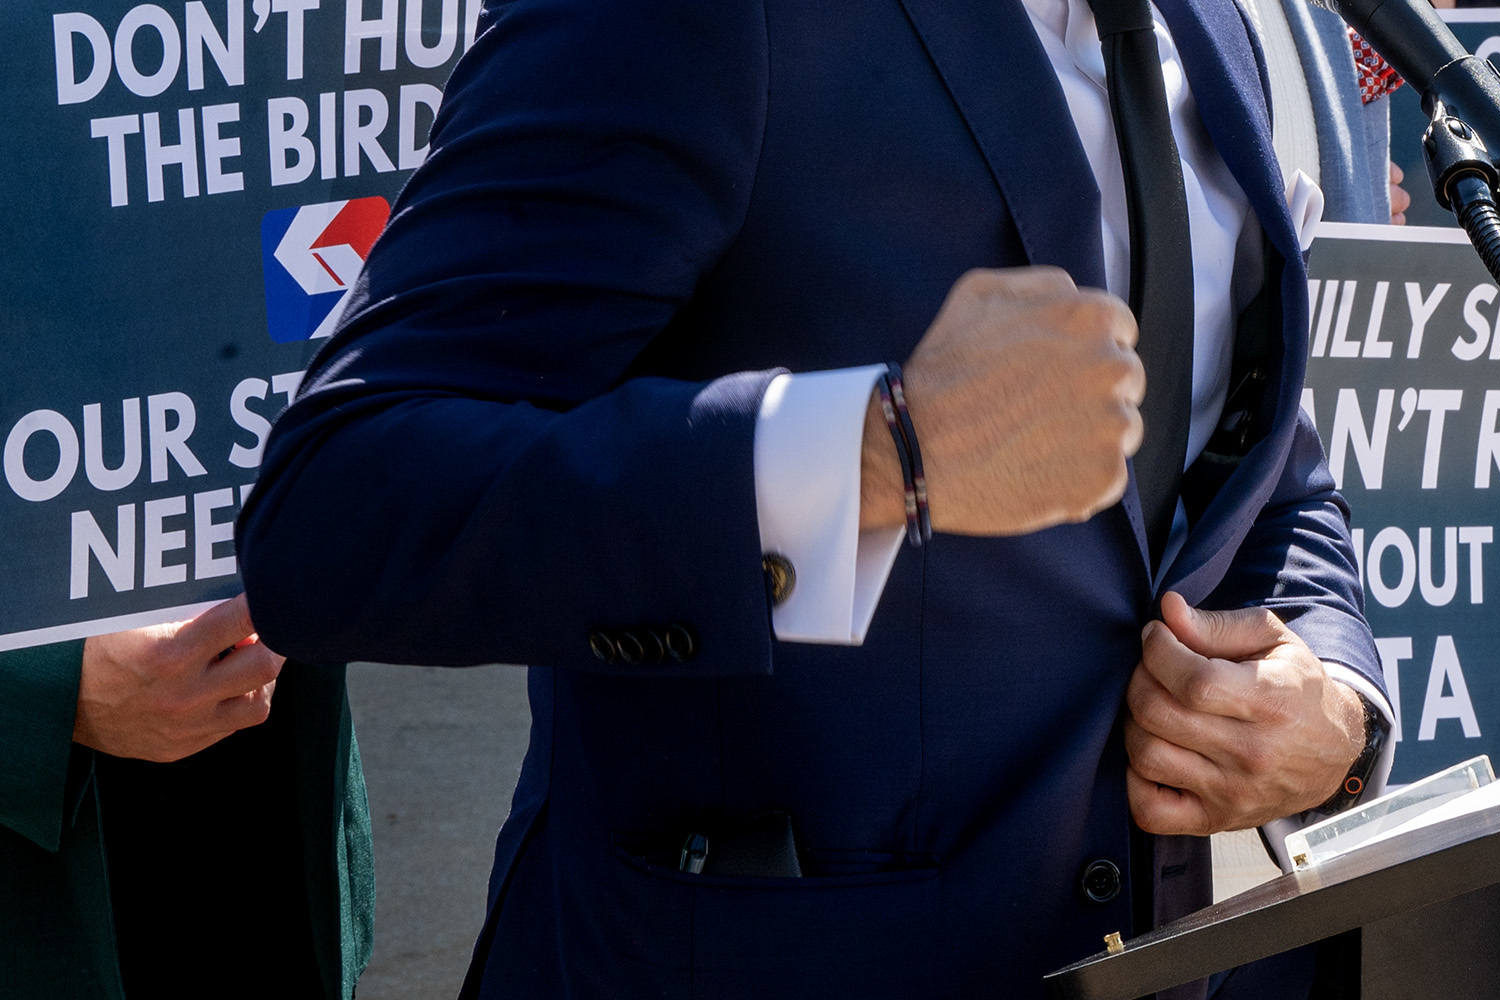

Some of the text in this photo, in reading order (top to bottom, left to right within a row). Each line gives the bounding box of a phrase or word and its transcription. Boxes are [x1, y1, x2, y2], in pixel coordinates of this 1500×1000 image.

[90, 83, 444, 208] THE BIRD
[1308, 279, 1452, 360] ILLY
[3, 389, 208, 502] OUR
[69, 483, 256, 601] NEE
